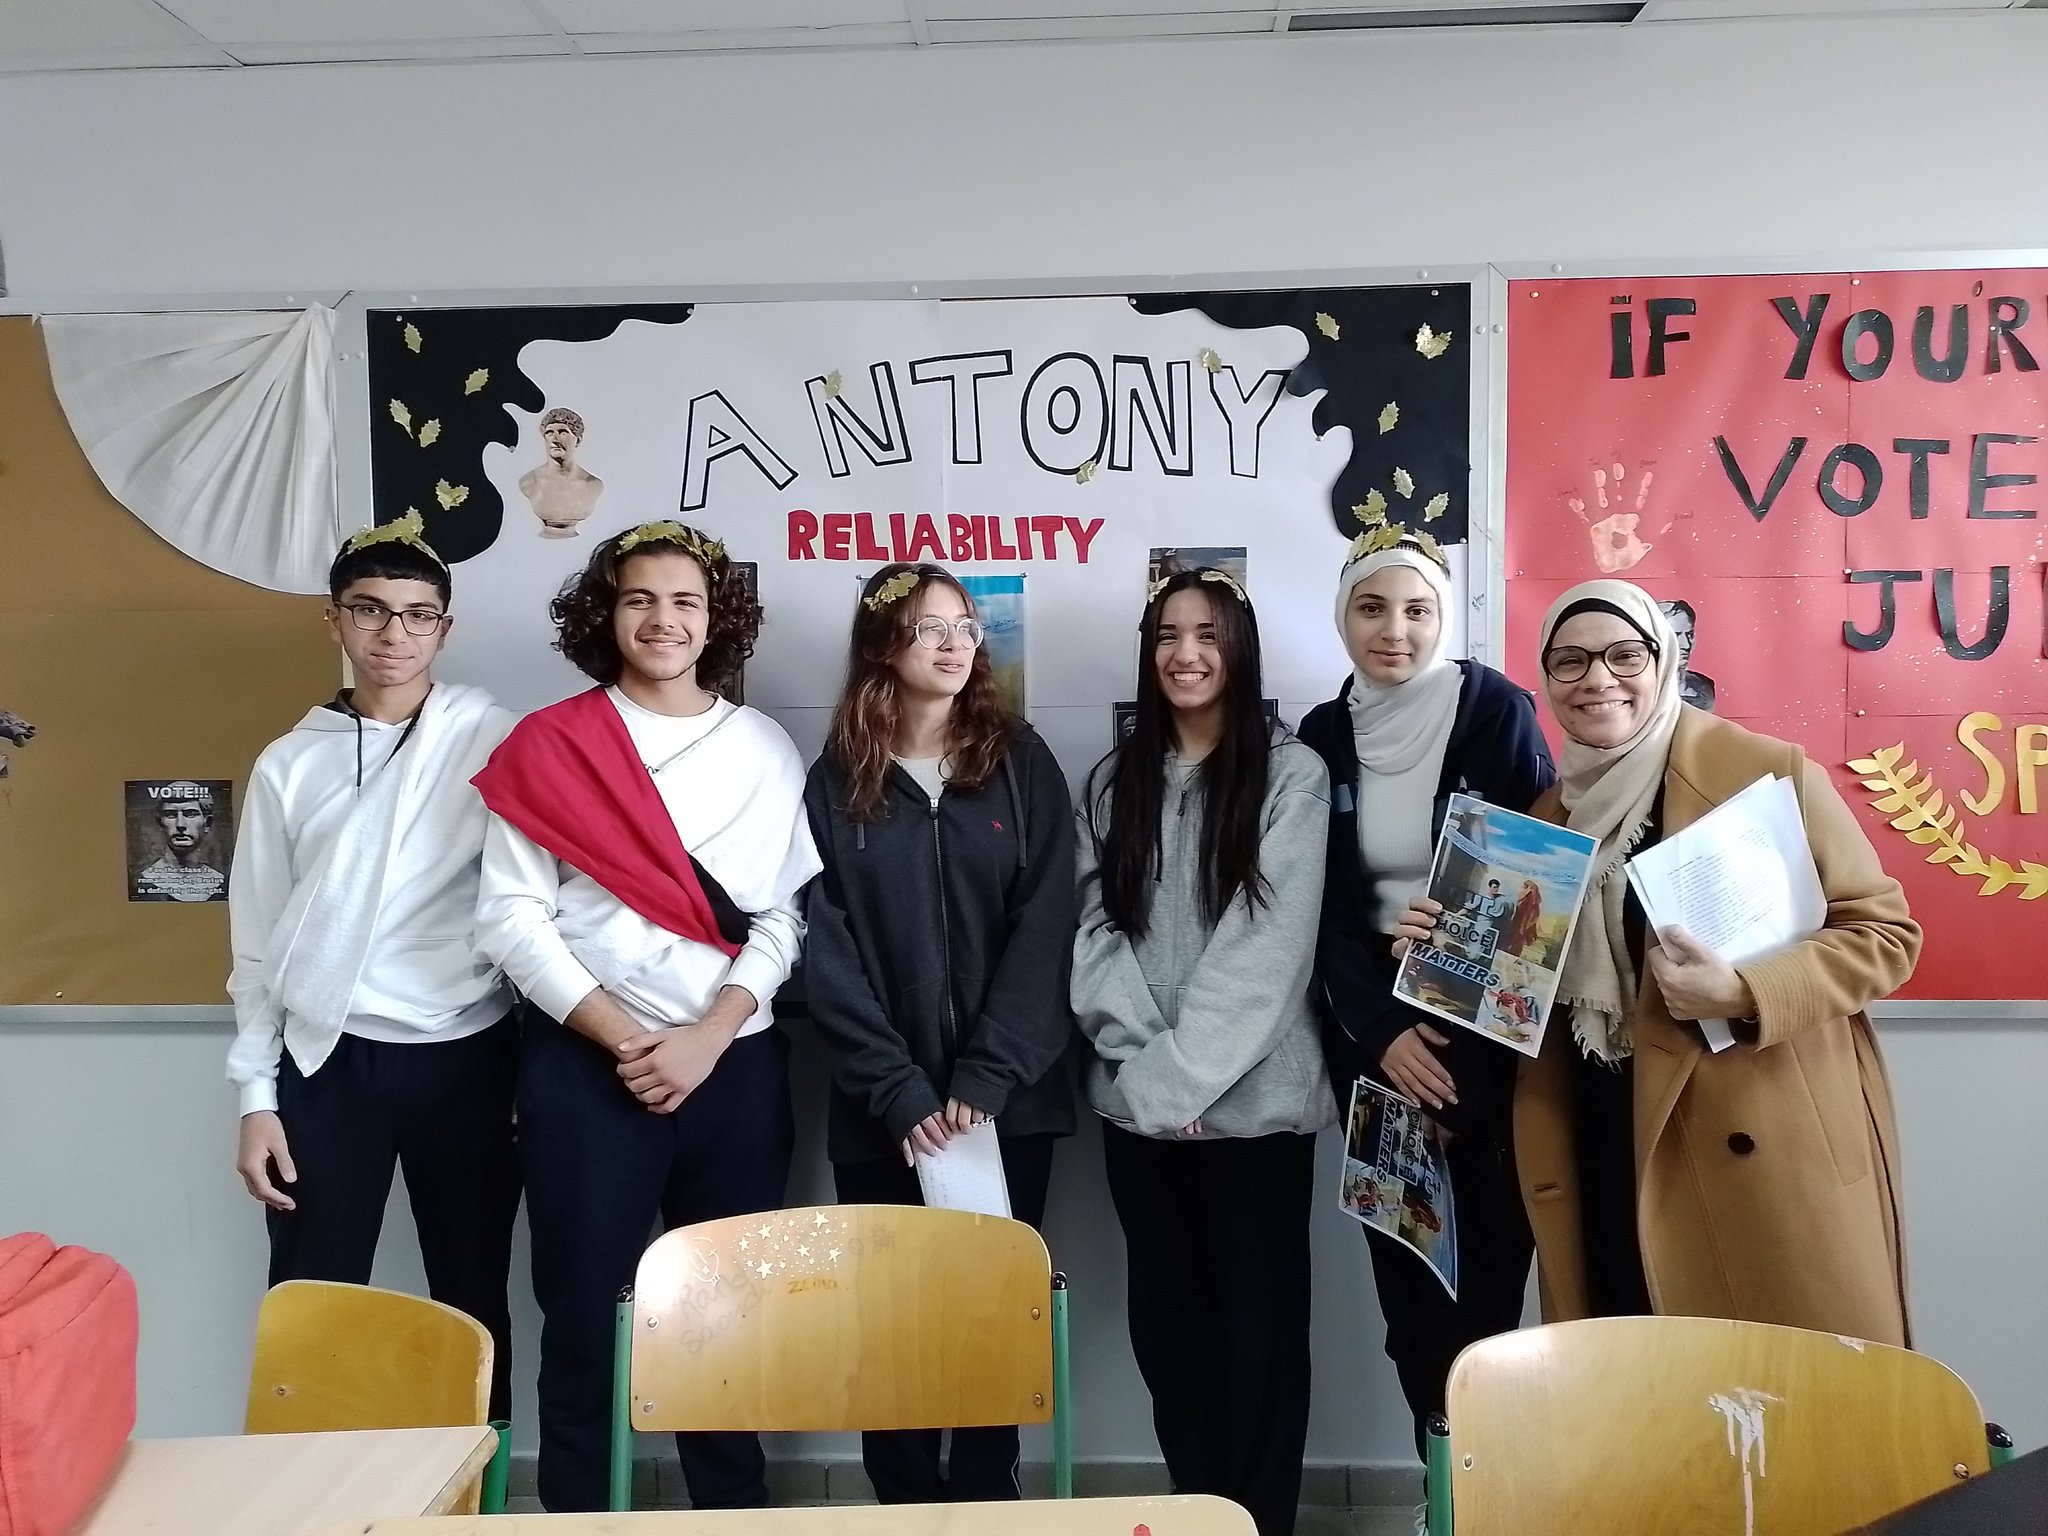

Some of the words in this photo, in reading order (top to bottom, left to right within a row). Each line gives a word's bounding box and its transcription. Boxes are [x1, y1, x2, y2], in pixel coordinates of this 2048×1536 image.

[679, 349, 1291, 512] ANTONY
[1713, 432, 2038, 523] VOTE
[787, 509, 1105, 565] RELIABILITY
[1843, 565, 2048, 661] JU
[147, 786, 210, 799] VOTE!!!
[180, 866, 202, 874] class
[1436, 917, 1495, 951] HOICE
[1410, 942, 1500, 988] MATTERS
[1376, 1095, 1398, 1184] MATTERS
